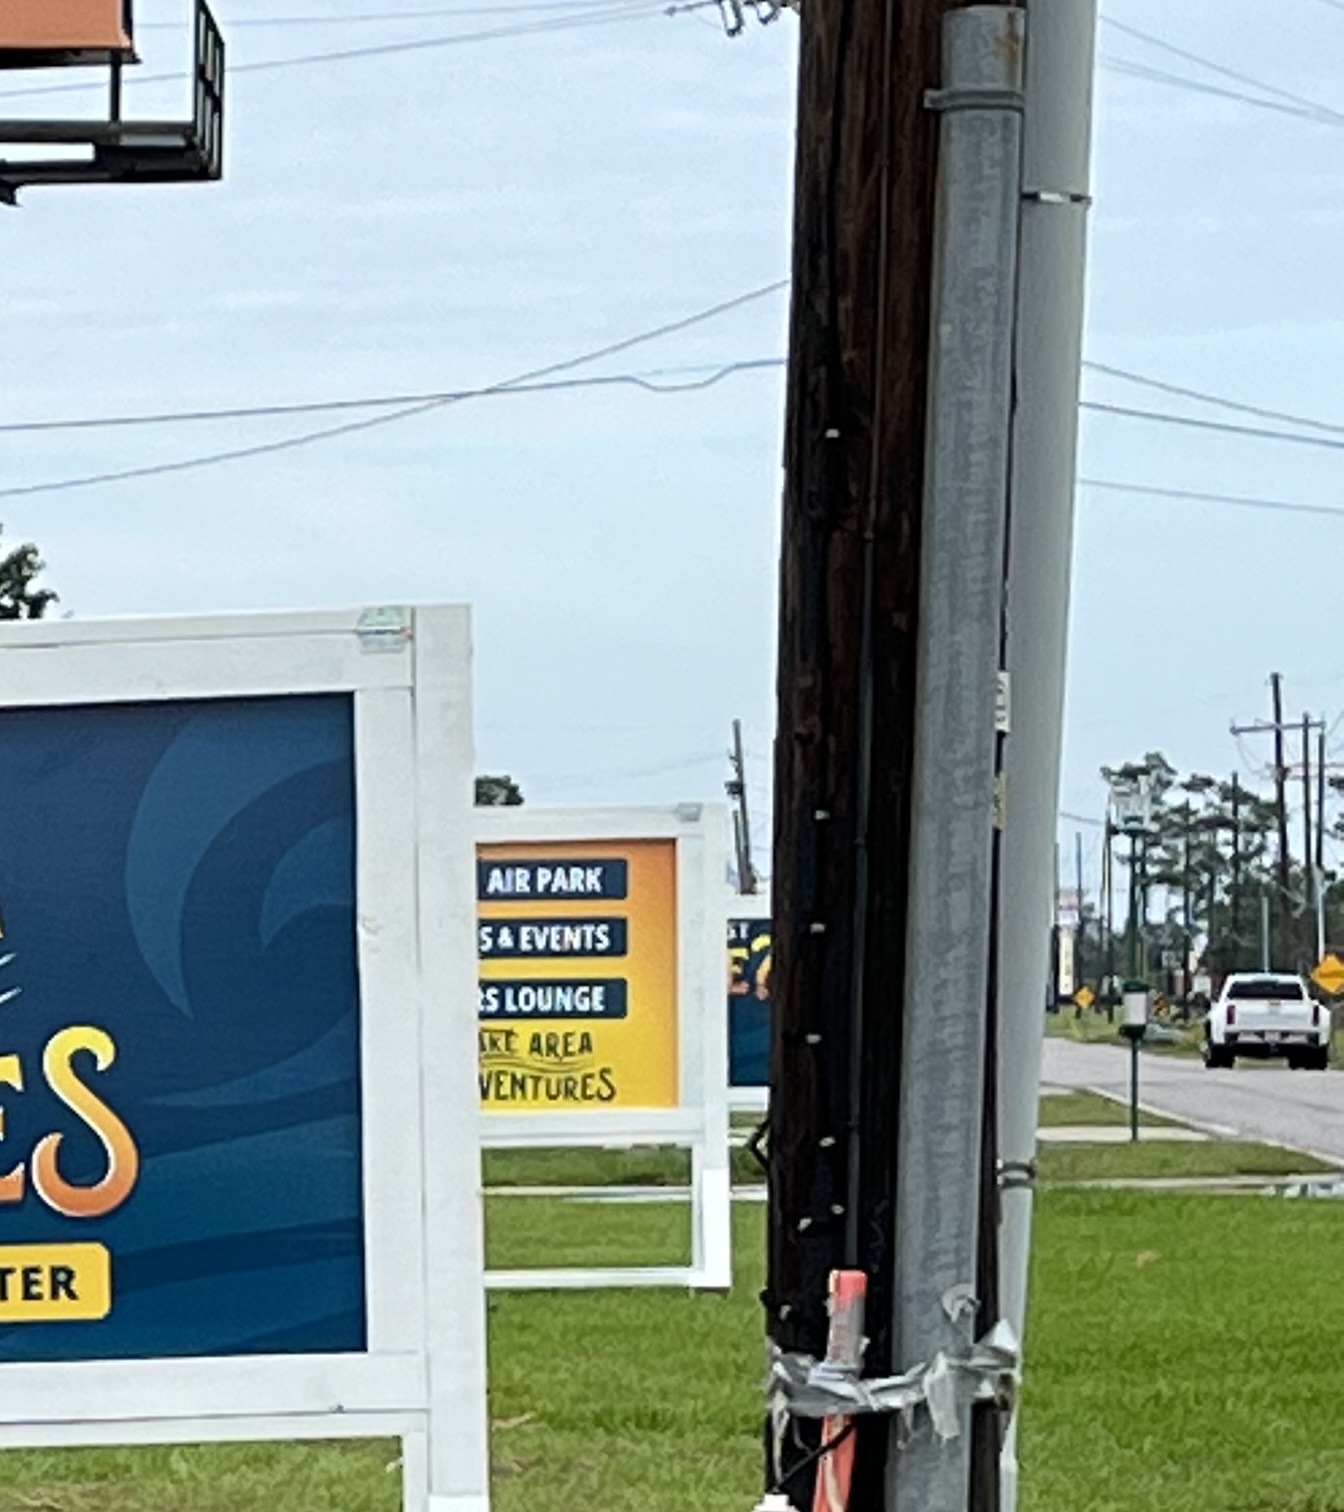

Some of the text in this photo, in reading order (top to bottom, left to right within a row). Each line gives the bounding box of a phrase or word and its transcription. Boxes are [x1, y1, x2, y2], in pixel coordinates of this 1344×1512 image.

[486, 866, 604, 894] AIR PARK
[497, 926, 514, 949] &
[519, 924, 610, 952] EVENTS
[505, 985, 606, 1012] LOUNGE
[528, 1031, 593, 1059] AREA
